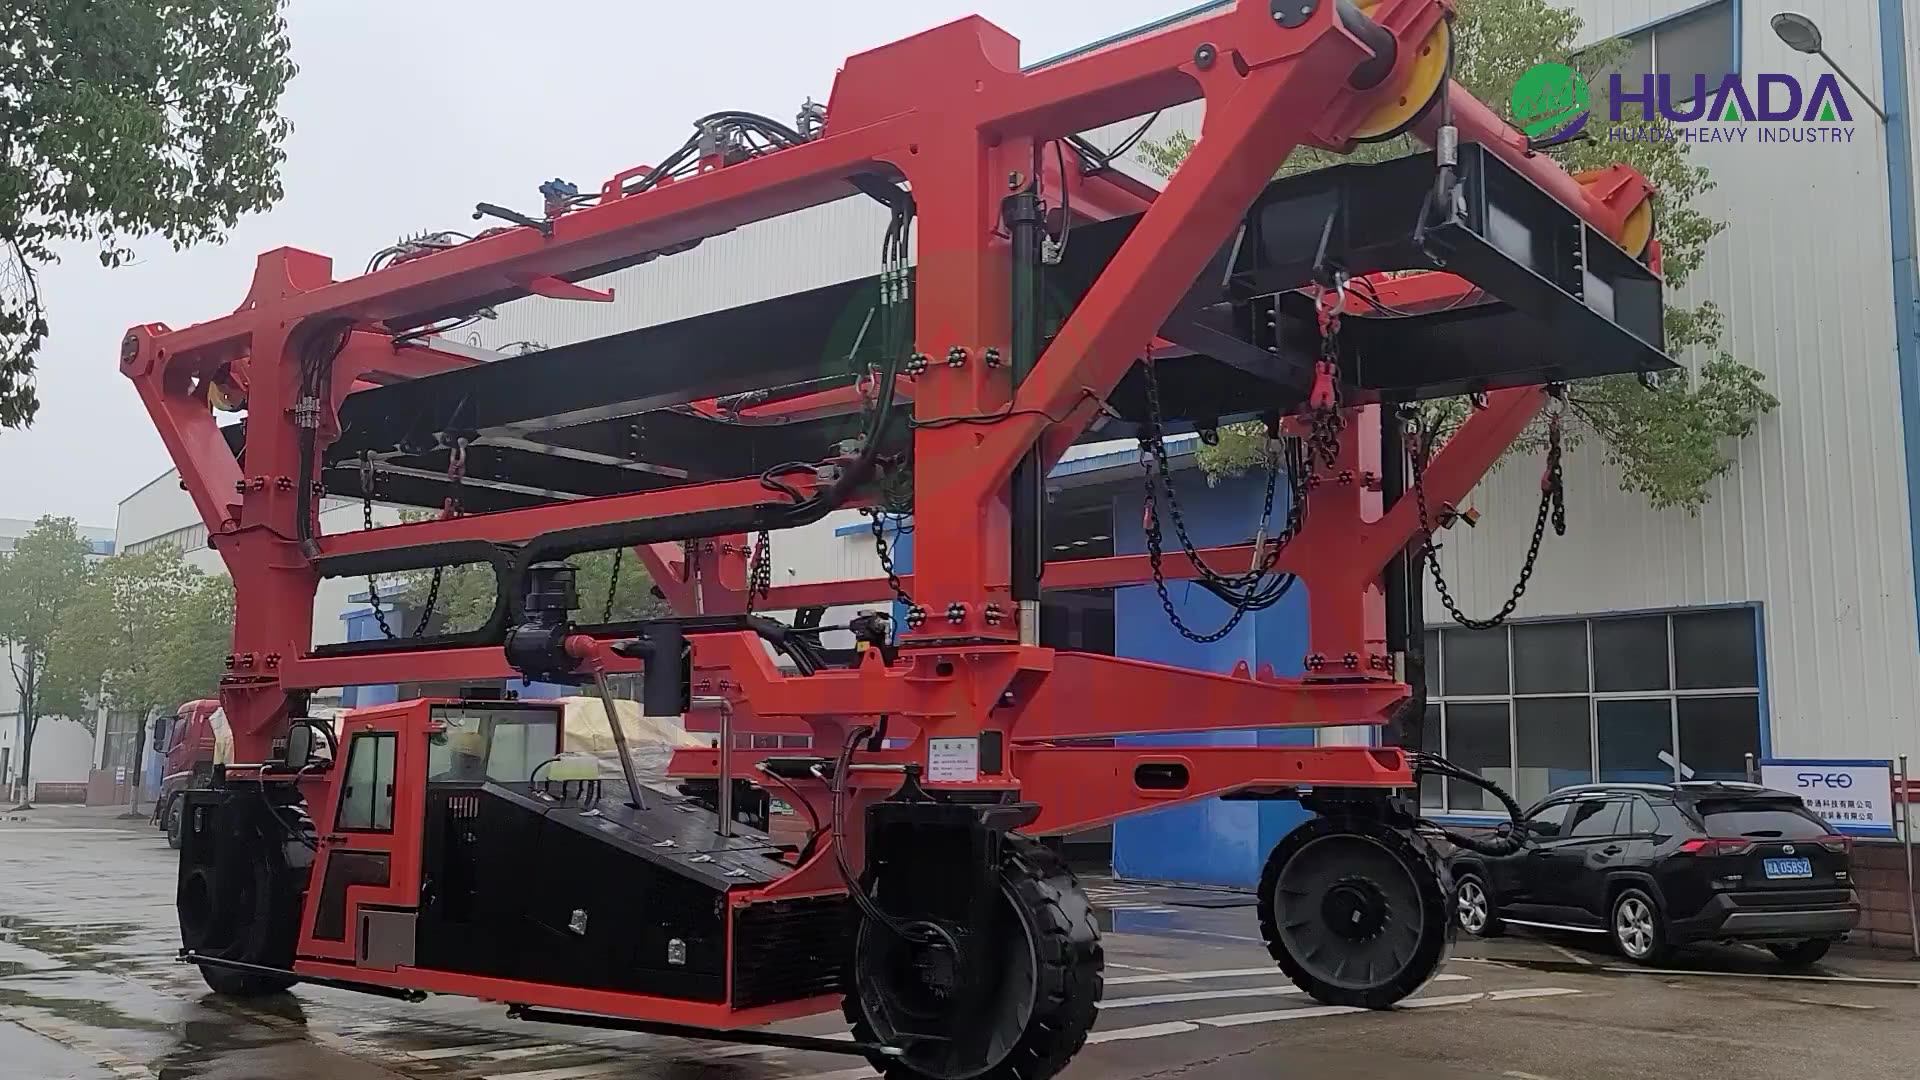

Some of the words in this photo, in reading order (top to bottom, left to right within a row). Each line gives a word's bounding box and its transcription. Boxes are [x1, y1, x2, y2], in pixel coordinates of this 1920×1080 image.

[1803, 799, 1873, 809] 势通科技有限公司
